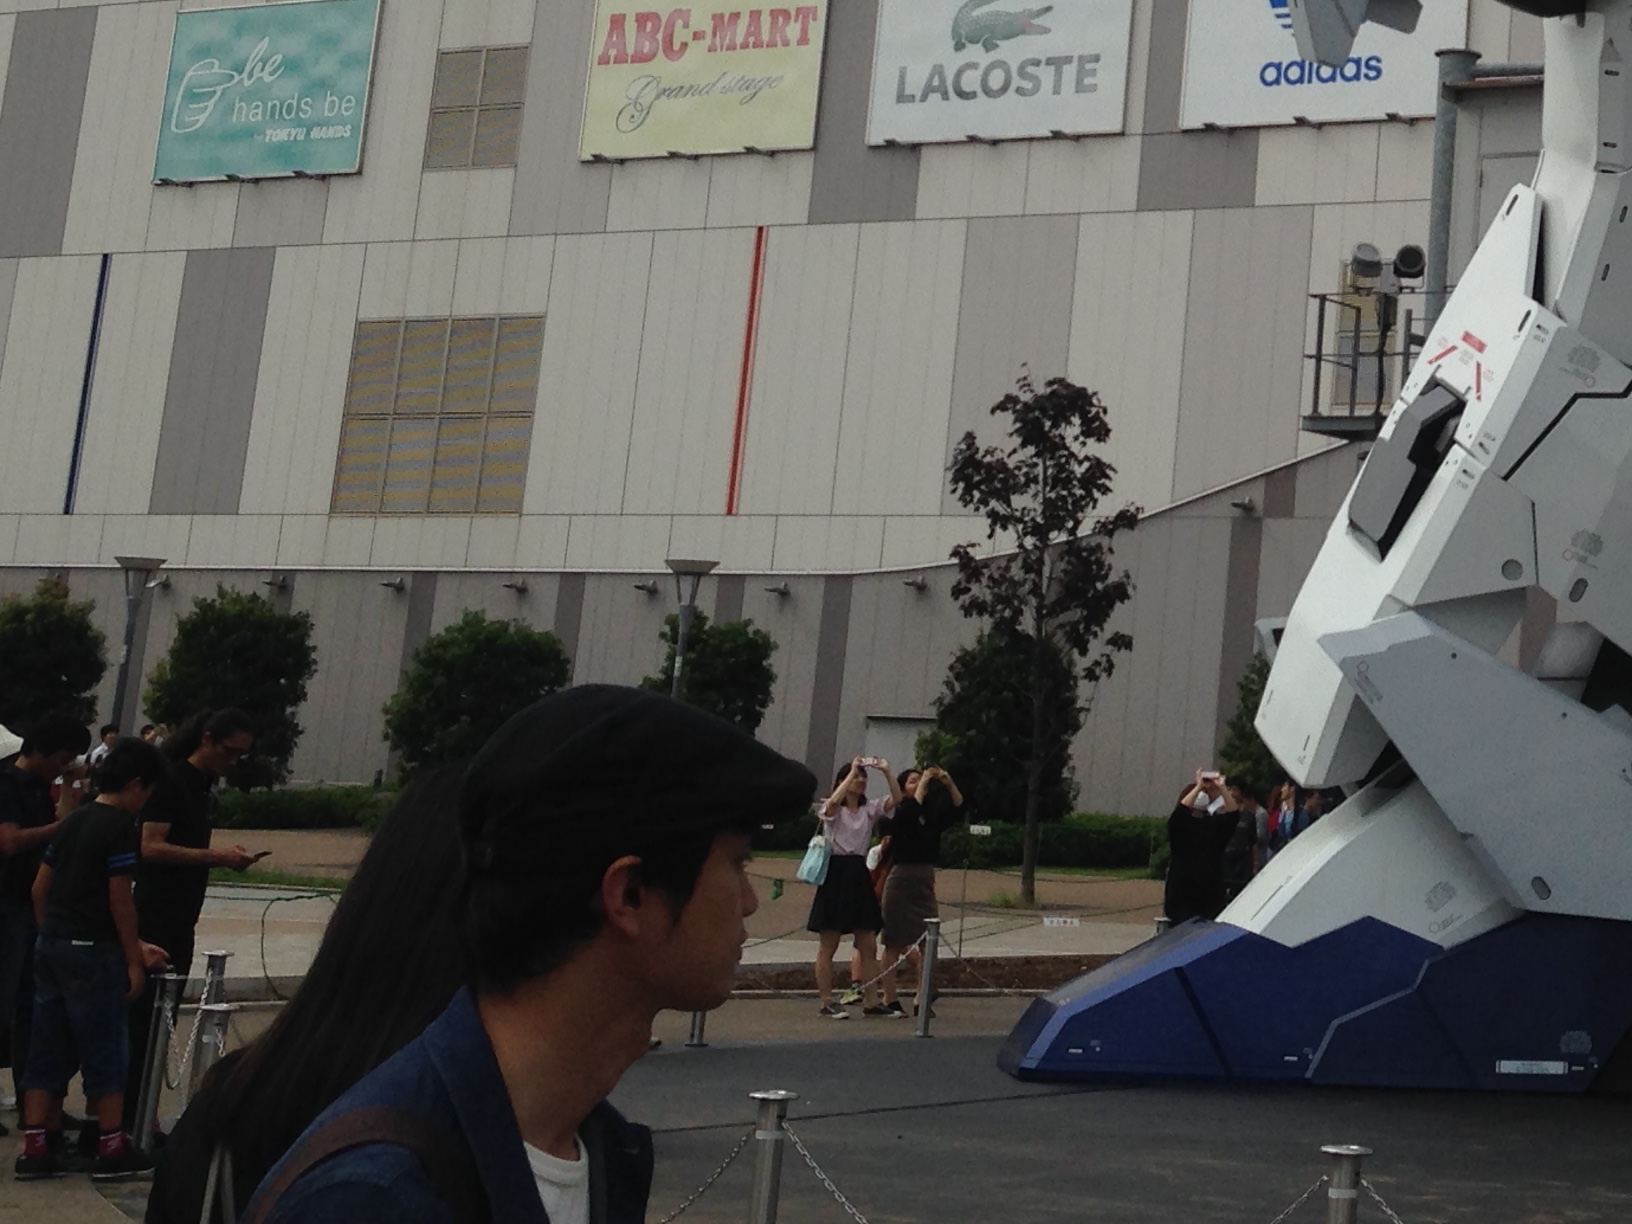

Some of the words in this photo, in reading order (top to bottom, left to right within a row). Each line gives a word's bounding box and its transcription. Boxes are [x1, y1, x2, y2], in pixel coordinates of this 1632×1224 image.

[597, 5, 818, 65] ABC-MART
[896, 53, 1101, 104] LACOSTE
[232, 92, 313, 123] hands
[323, 90, 356, 117] be
[264, 127, 307, 143] TOKYU
[310, 123, 353, 139] HANDS
